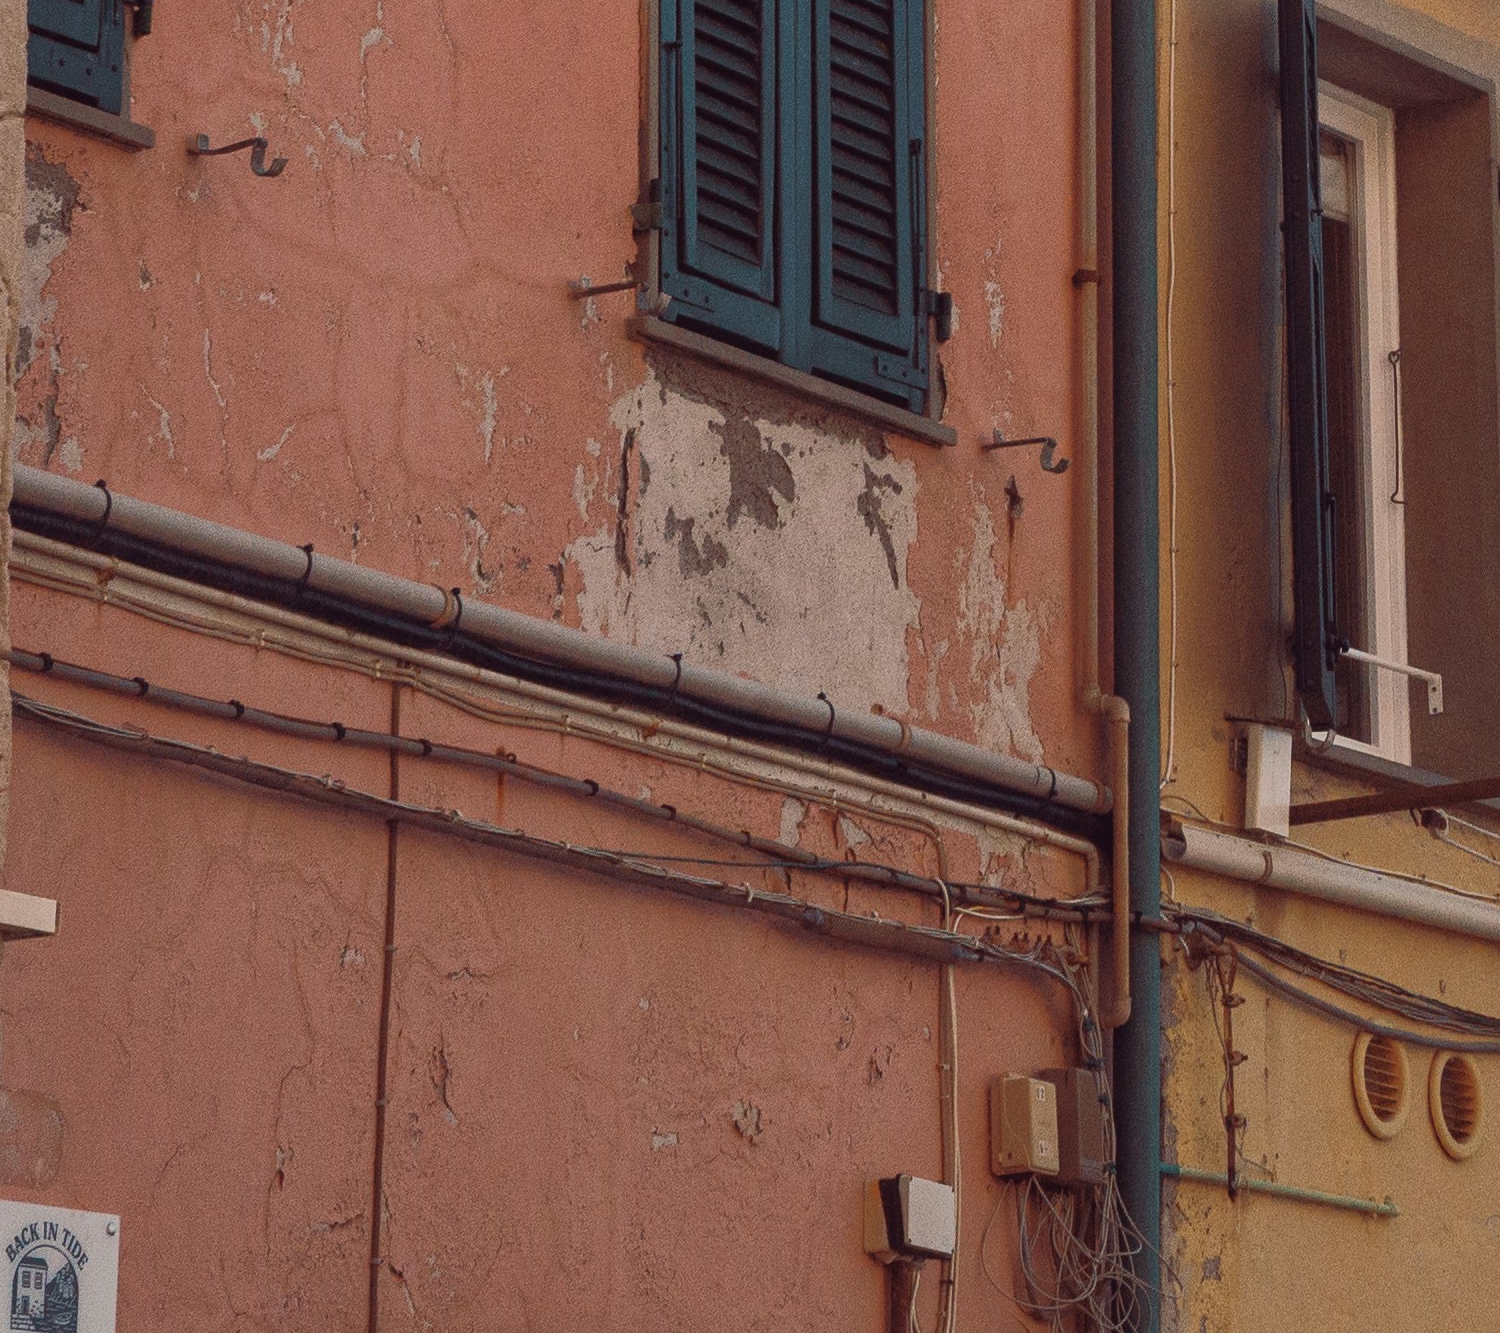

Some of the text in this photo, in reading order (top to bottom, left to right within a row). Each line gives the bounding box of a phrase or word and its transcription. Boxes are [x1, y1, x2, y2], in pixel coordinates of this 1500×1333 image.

[5, 1221, 89, 1272] BACK IN TIDE
